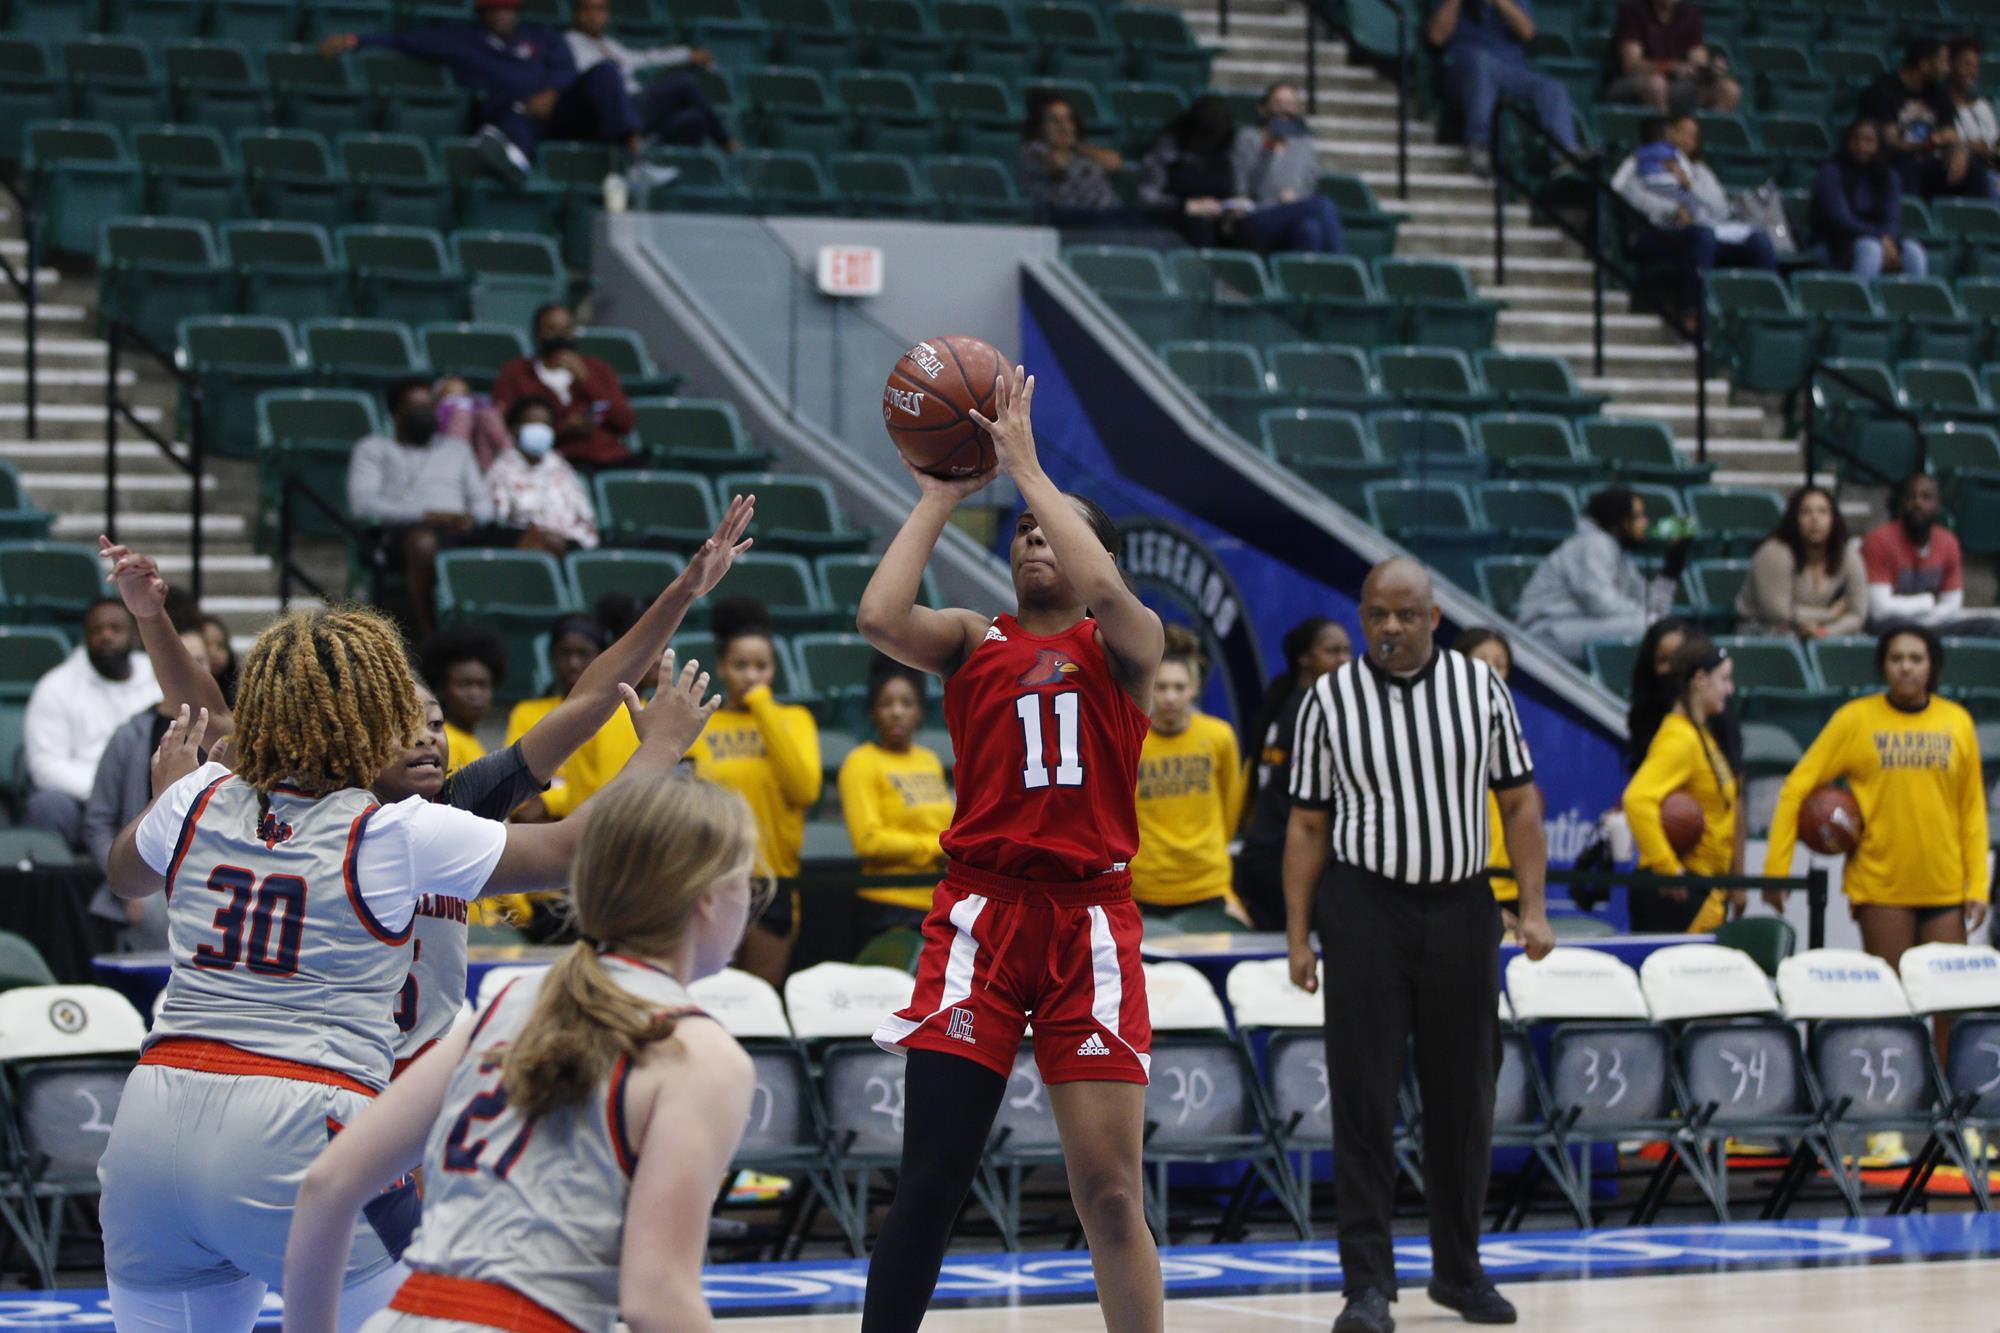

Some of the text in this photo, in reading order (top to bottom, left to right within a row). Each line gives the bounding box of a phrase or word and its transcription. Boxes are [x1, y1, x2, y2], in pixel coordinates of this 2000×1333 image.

[832, 251, 873, 289] EXIT
[1126, 530, 1238, 639] LEGENDS
[1016, 691, 1083, 789] 11
[192, 863, 308, 978] 30
[1076, 1046, 1110, 1056] adidas
[1584, 1046, 1628, 1109] 33
[1719, 1049, 1767, 1104] 34
[1850, 1047, 1904, 1105] 35
[74, 1087, 113, 1132] 2
[1009, 1066, 1042, 1113] 2
[1162, 1064, 1213, 1126] 30
